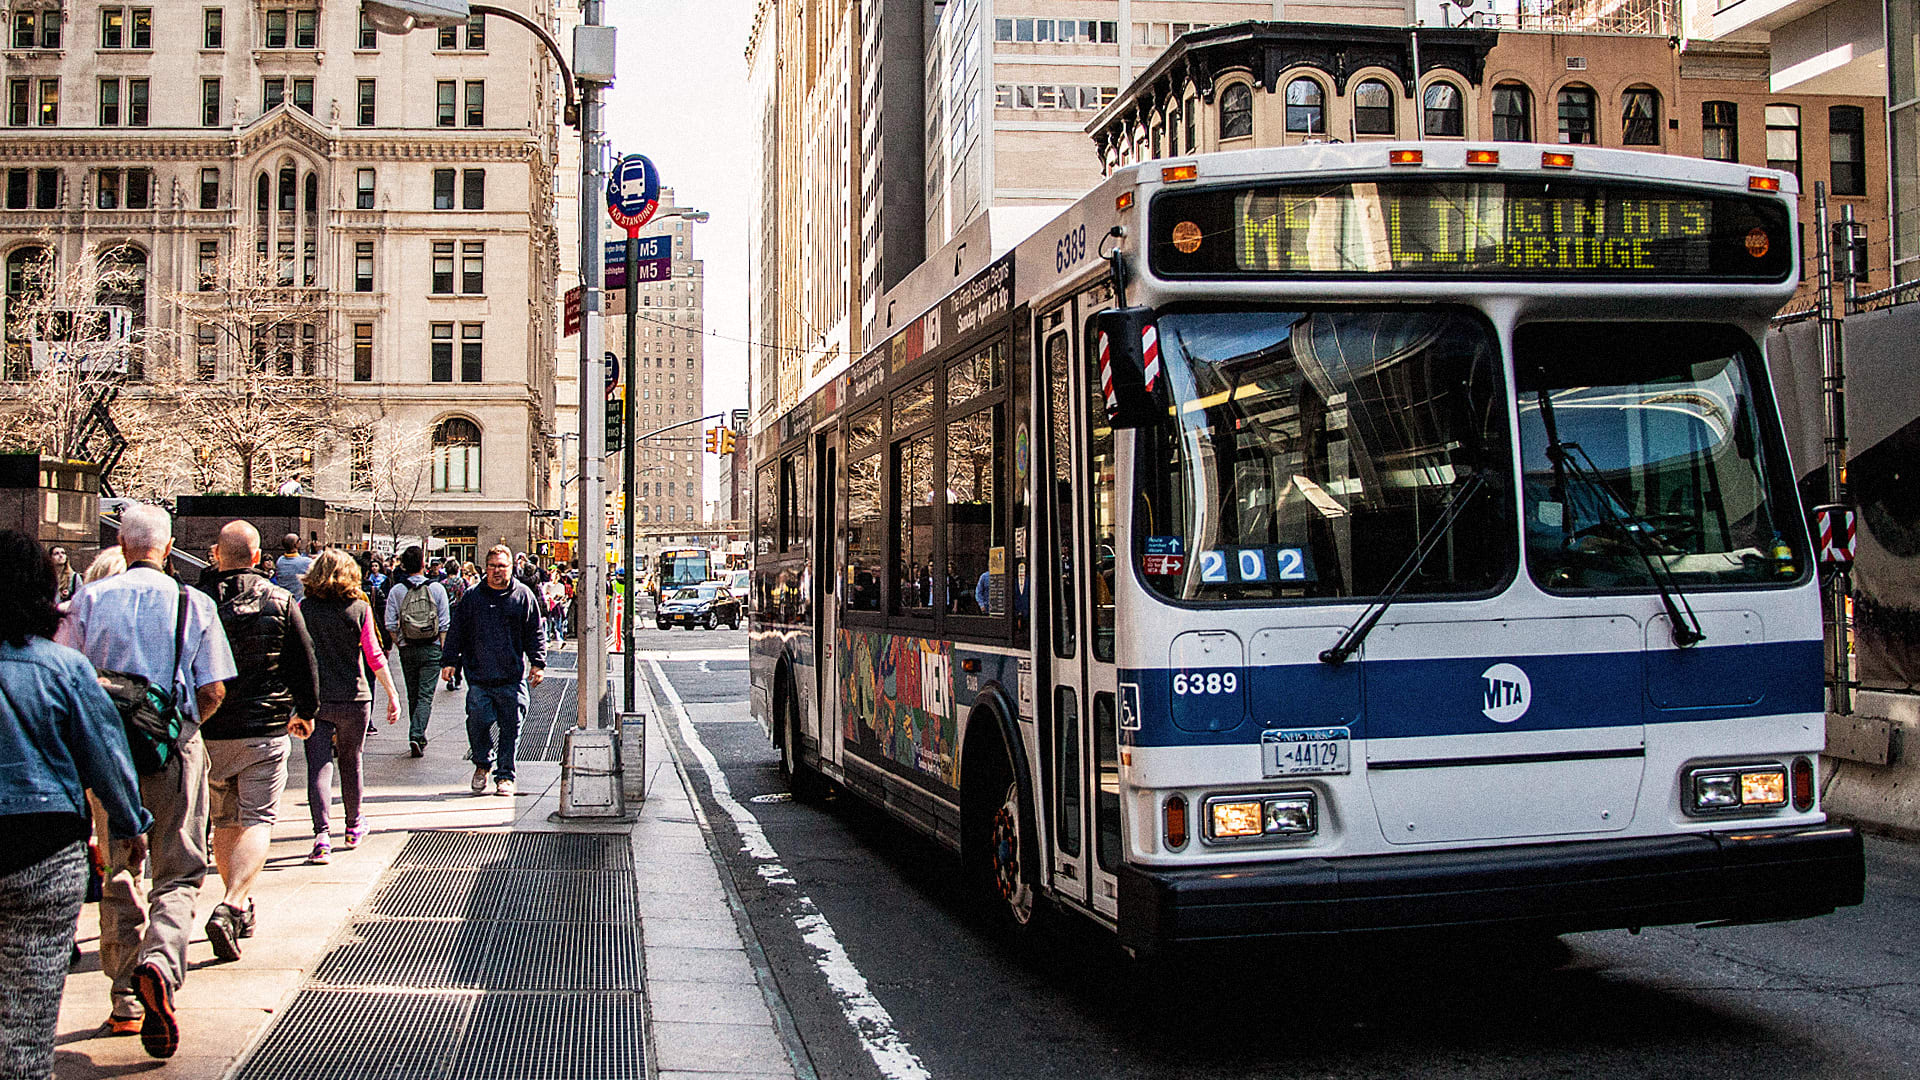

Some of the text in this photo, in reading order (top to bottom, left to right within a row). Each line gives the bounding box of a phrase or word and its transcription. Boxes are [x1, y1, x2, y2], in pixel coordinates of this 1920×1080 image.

[621, 203, 654, 226] STANDING
[640, 239, 658, 258] M5
[1056, 223, 1086, 274] 6389
[639, 262, 658, 280] M5
[921, 651, 950, 719] MEN
[1173, 672, 1237, 695] 6389
[1482, 677, 1523, 710] MTA
